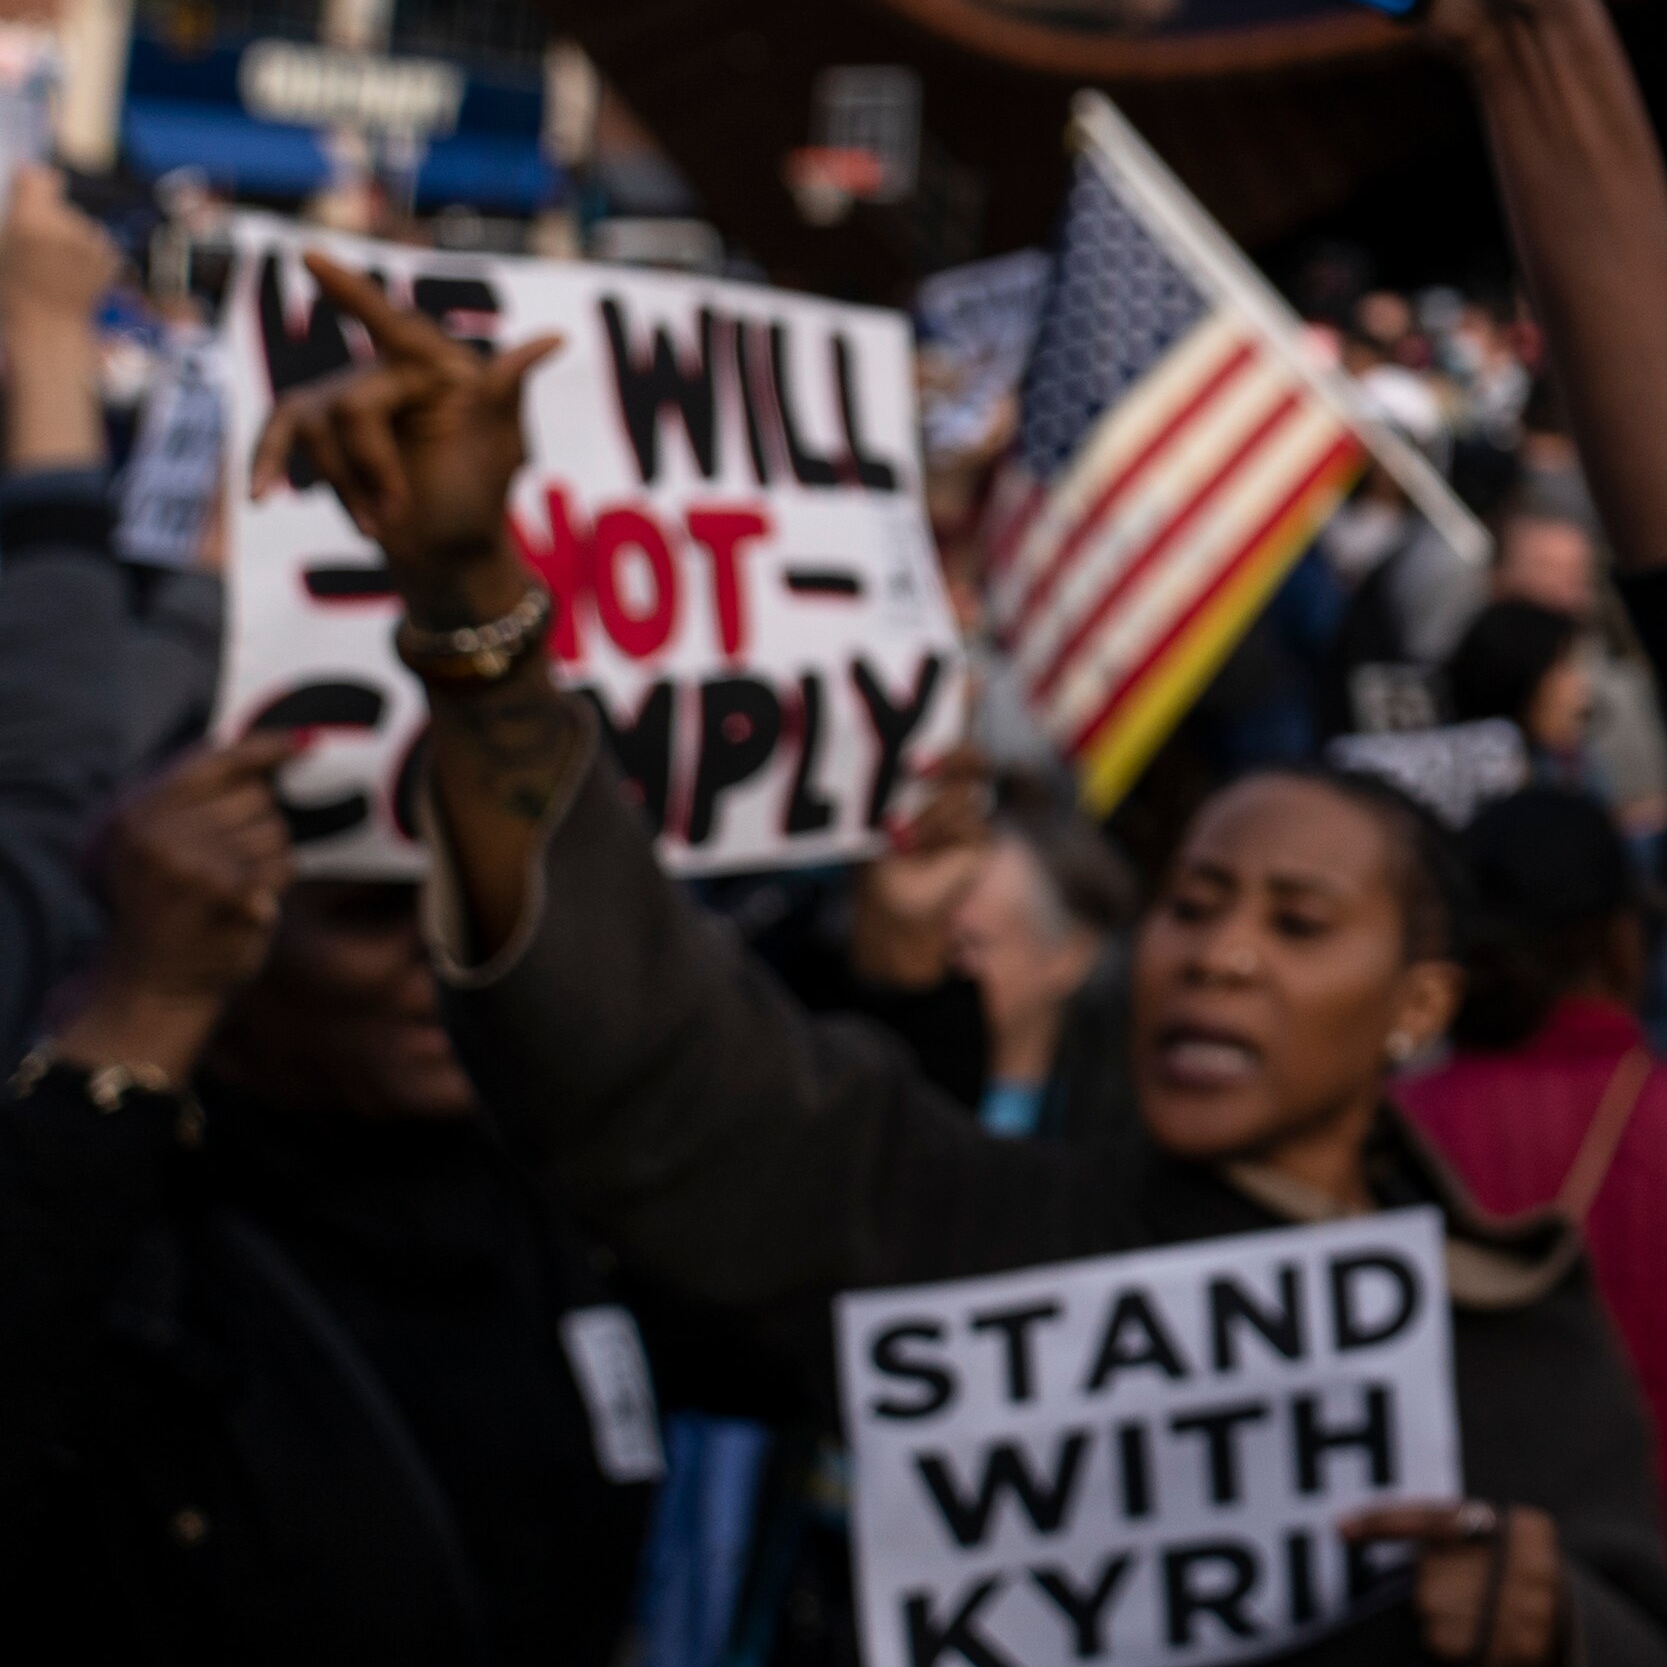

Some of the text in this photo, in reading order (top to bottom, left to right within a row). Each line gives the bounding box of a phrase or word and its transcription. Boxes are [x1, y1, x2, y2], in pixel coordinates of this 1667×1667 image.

[600, 294, 897, 492] WILL
[240, 650, 942, 846] CMPLY
[870, 1249, 1424, 1424] STAND
[914, 1382, 1398, 1548] WITH
